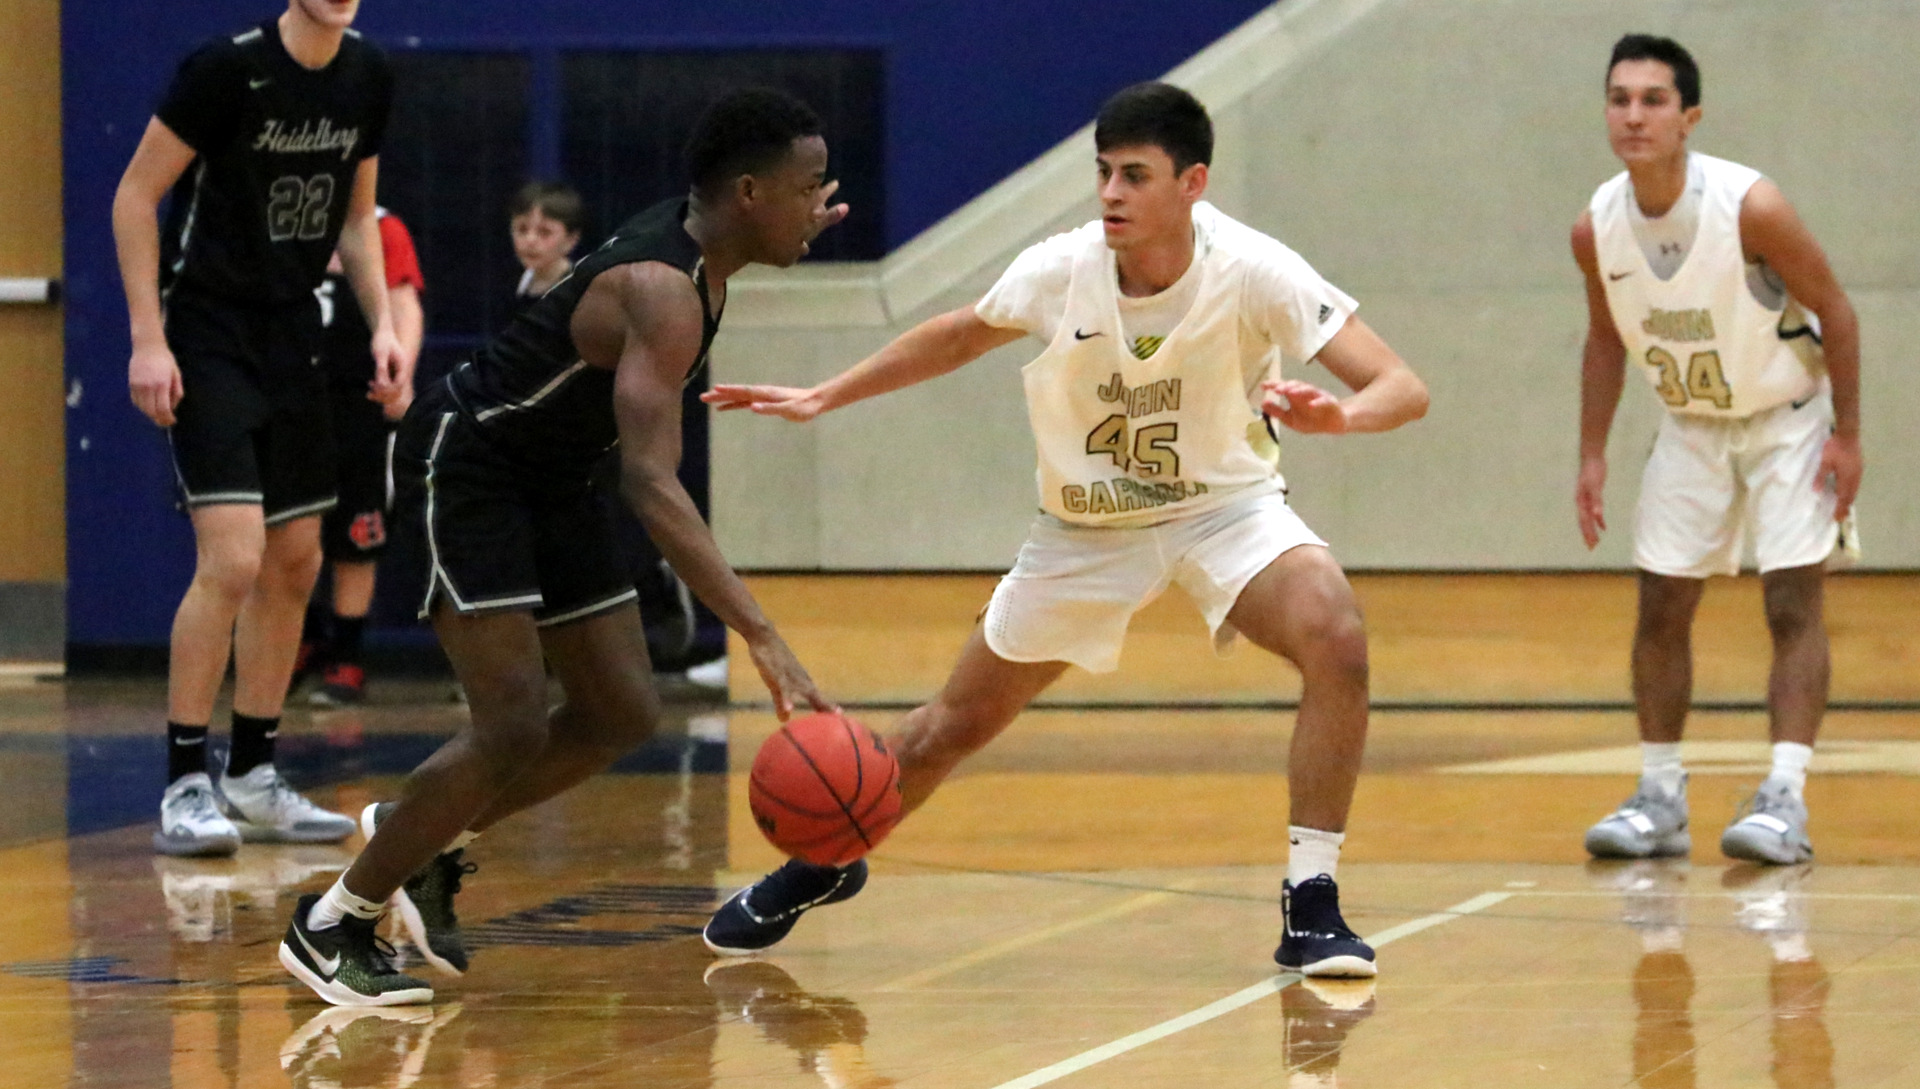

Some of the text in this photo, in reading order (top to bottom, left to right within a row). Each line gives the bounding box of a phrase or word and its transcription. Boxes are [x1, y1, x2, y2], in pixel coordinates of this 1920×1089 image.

[253, 117, 358, 161] Heidelberg
[267, 173, 335, 242] 22
[1645, 345, 1732, 409] 34
[1086, 413, 1179, 478] 45
